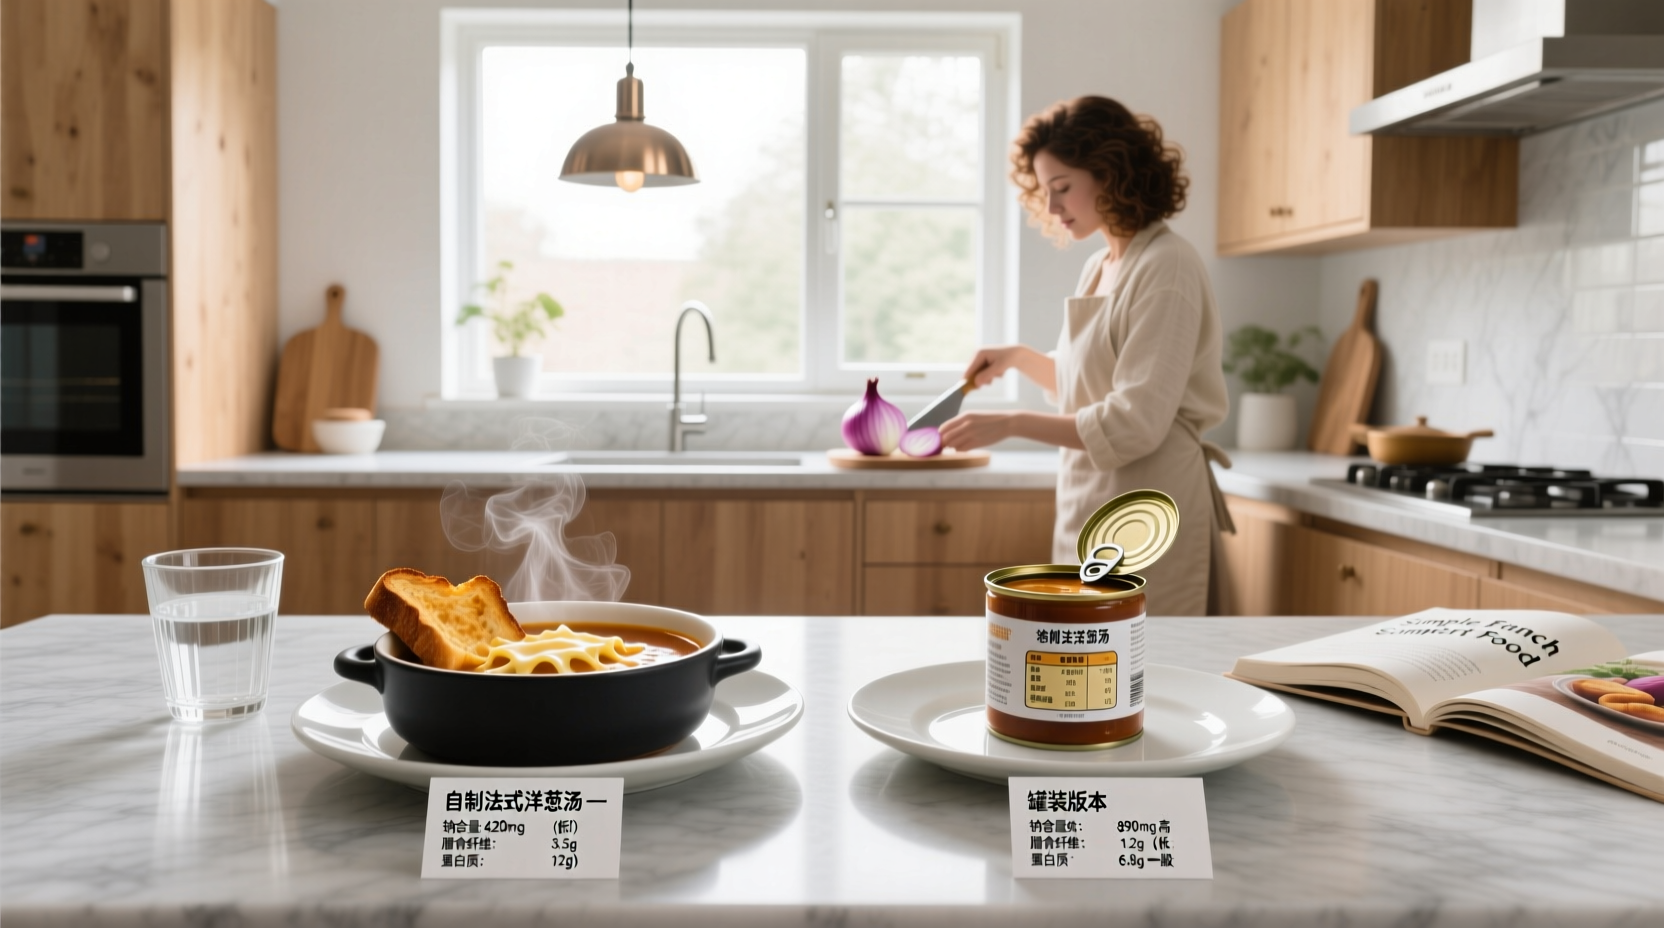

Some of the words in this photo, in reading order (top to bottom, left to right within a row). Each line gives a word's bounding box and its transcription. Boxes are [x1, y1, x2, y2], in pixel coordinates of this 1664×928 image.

[1476, 630, 1541, 668] Food
[1028, 789, 1107, 812] 罐装版本
